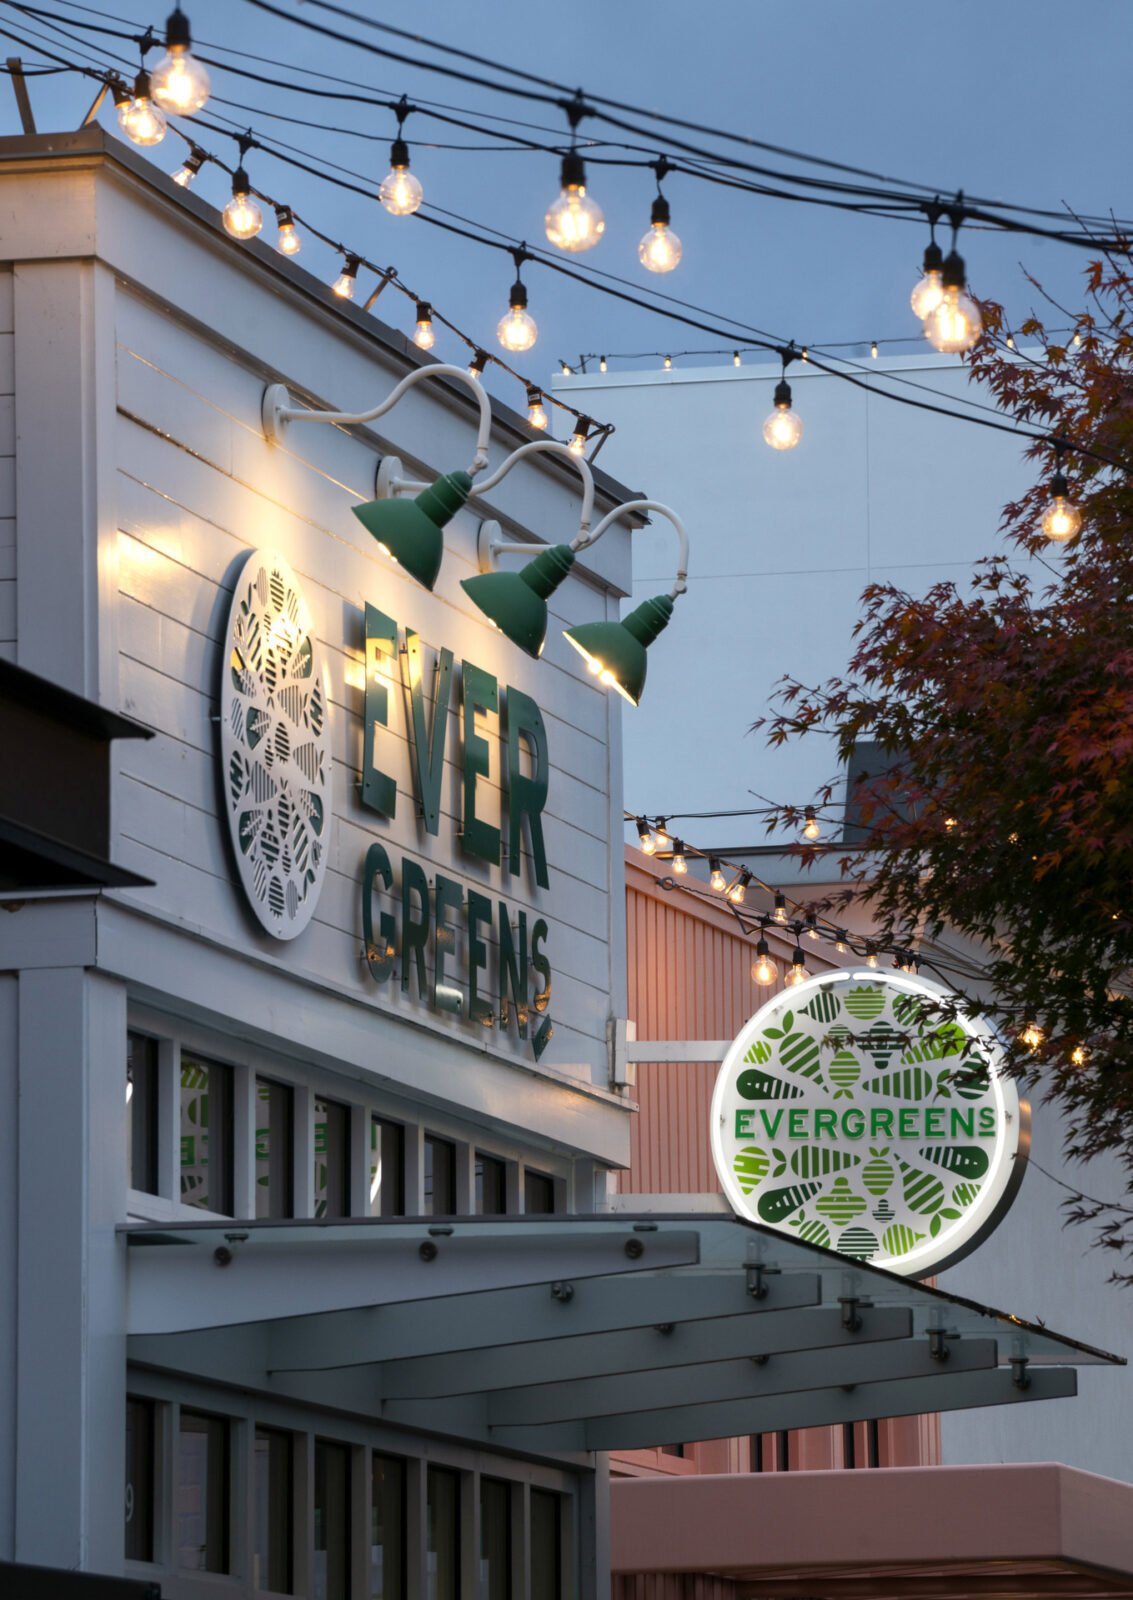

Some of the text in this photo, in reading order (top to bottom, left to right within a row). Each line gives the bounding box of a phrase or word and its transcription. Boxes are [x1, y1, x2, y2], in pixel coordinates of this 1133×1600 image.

[361, 601, 550, 891] EVER
[361, 842, 553, 1062] GREENS
[735, 1106, 996, 1139] EVERGREENS
